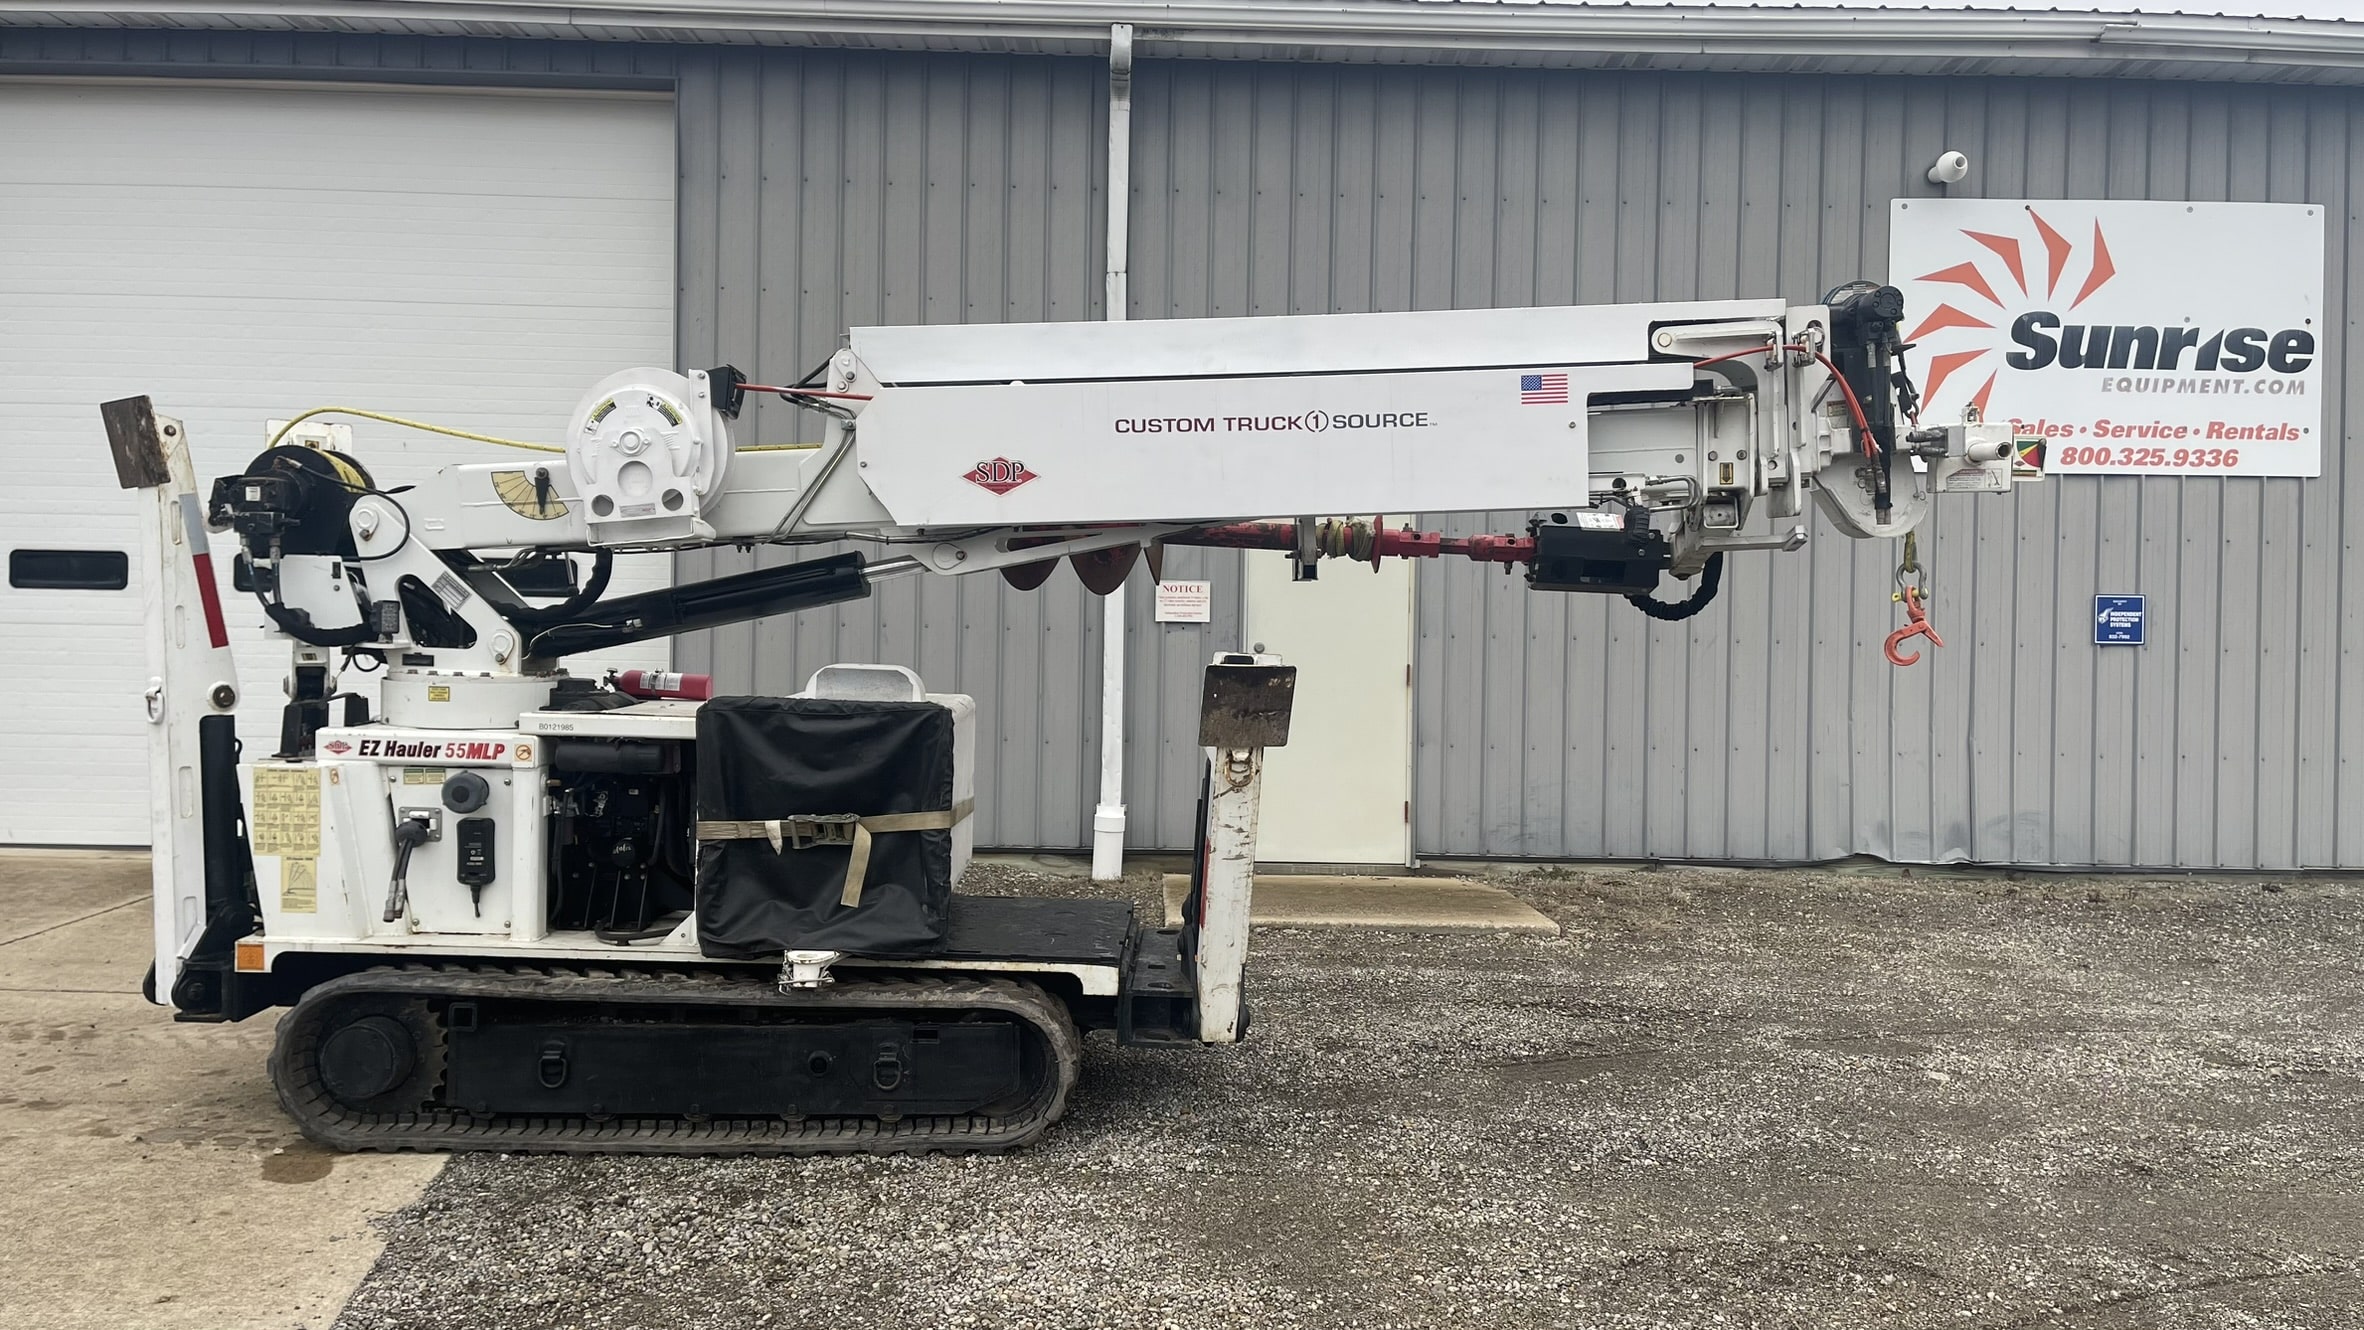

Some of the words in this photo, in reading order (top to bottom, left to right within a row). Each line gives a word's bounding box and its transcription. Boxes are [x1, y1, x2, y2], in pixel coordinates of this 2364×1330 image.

[2006, 311, 2315, 373] Sunrise
[2101, 376, 2306, 396] EQUIPMENT.COM
[1115, 417, 1215, 433] CUSTOM
[1223, 415, 1303, 431] TRUCK
[1332, 412, 1428, 429] SOURCE
[2007, 418, 2073, 438] Sales
[2093, 419, 2188, 440] Service
[2206, 421, 2300, 441] Rentals
[2060, 447, 2239, 467] 800.325.9336
[976, 461, 1025, 482] SDP
[1162, 585, 1203, 593] NOTICE
[358, 740, 380, 757] EZ
[384, 740, 442, 758] Hauler
[444, 742, 506, 760] 55MLP
